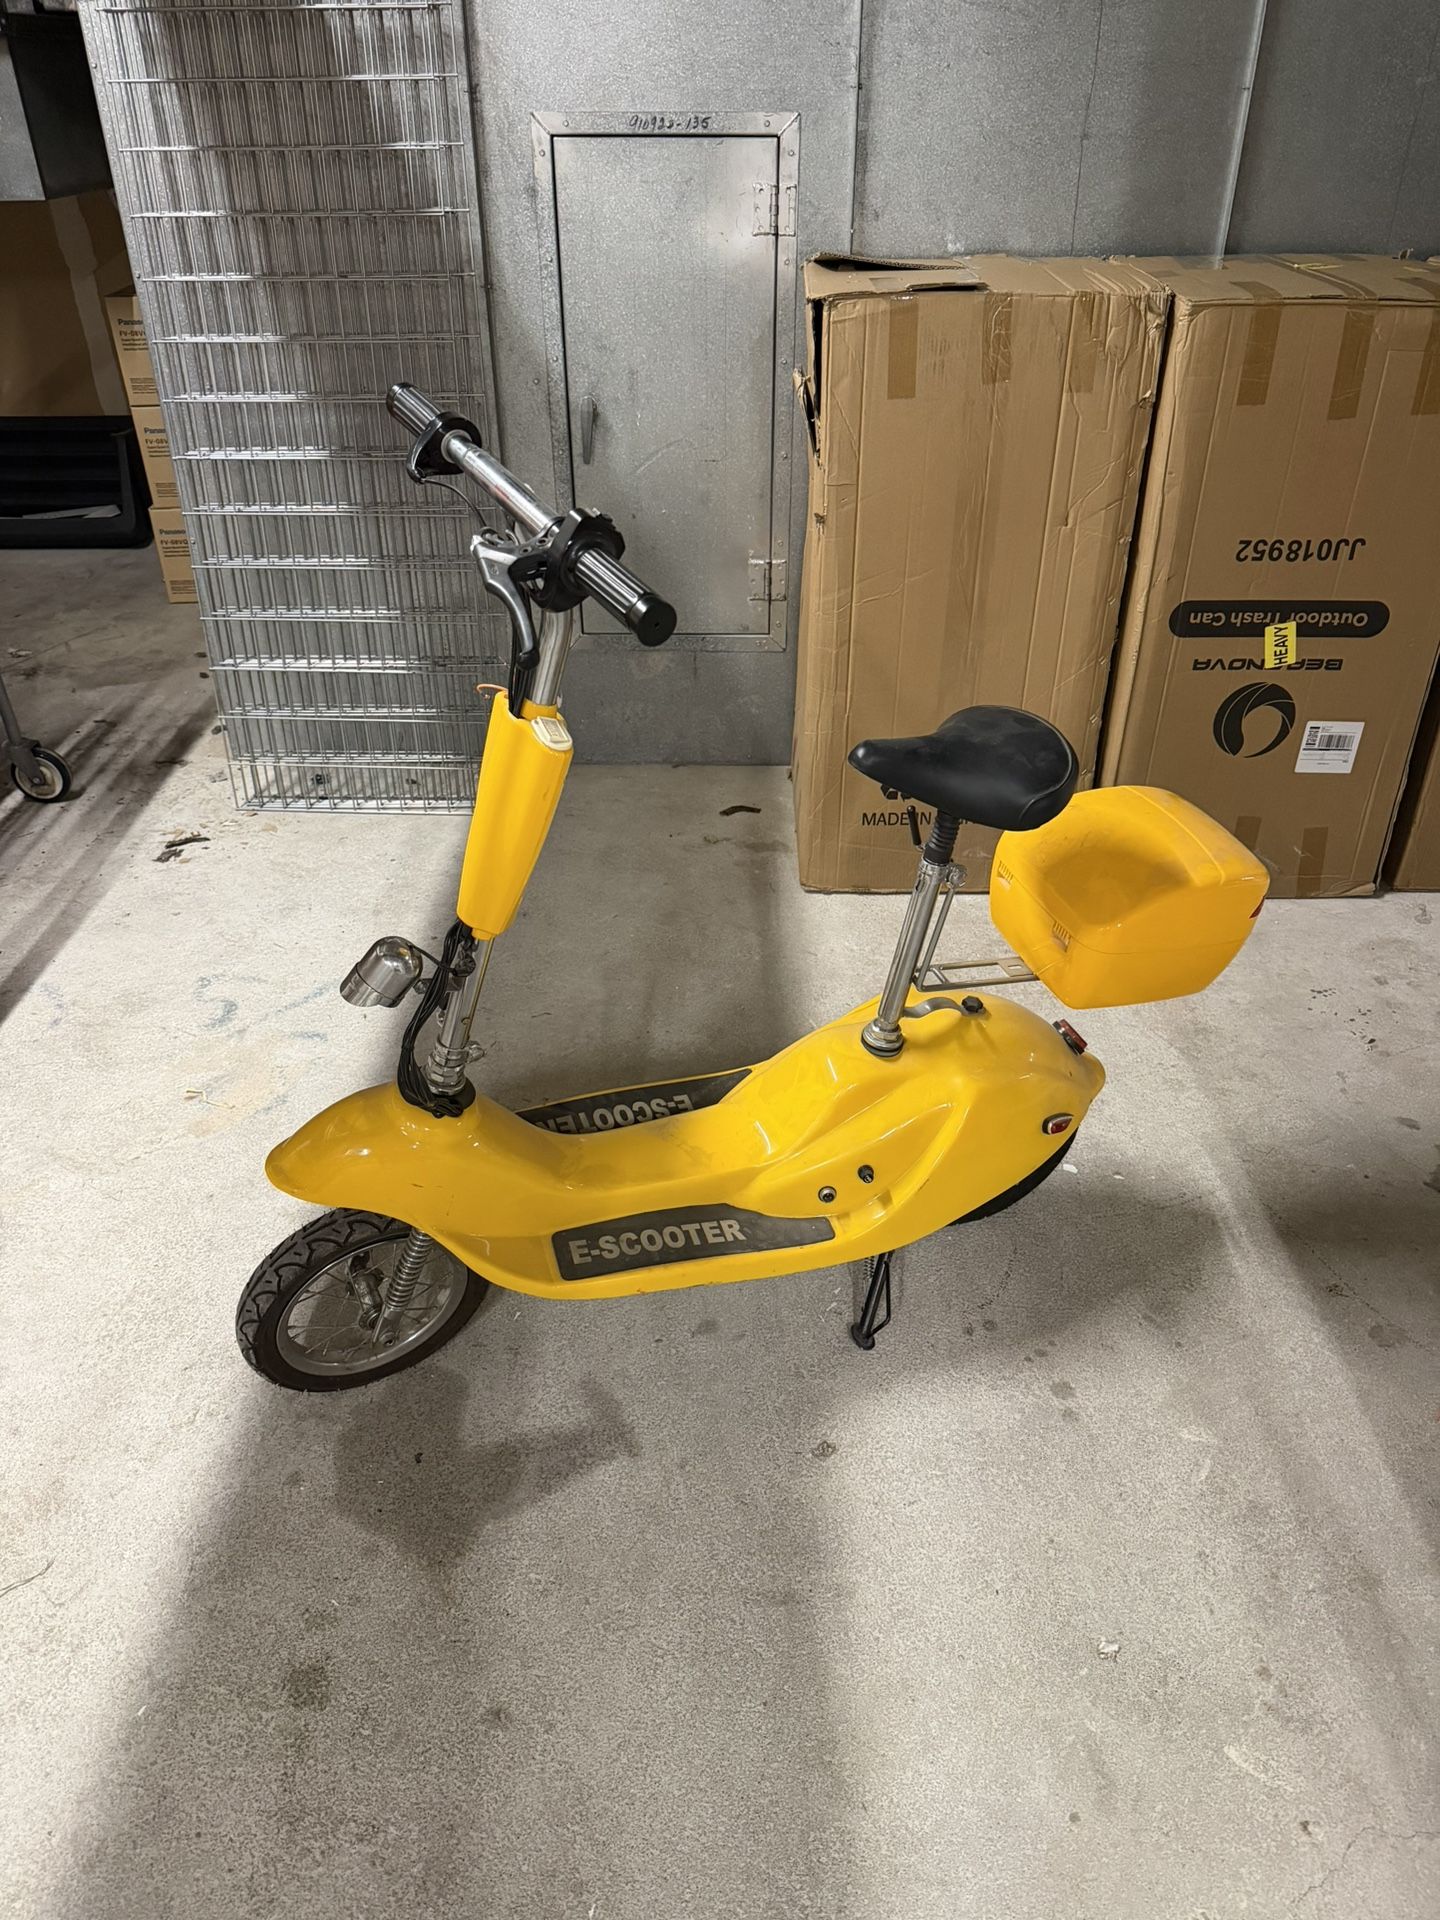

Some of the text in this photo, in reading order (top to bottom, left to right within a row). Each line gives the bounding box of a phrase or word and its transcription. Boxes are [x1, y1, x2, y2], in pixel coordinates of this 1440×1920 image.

[1235, 538, 1366, 563] JJ018952
[1188, 611, 1369, 628] Outdoor Trash Can
[1274, 625, 1289, 666] HEAVY
[861, 812, 910, 826] MADE
[568, 1218, 747, 1266] E-SCOOTER
